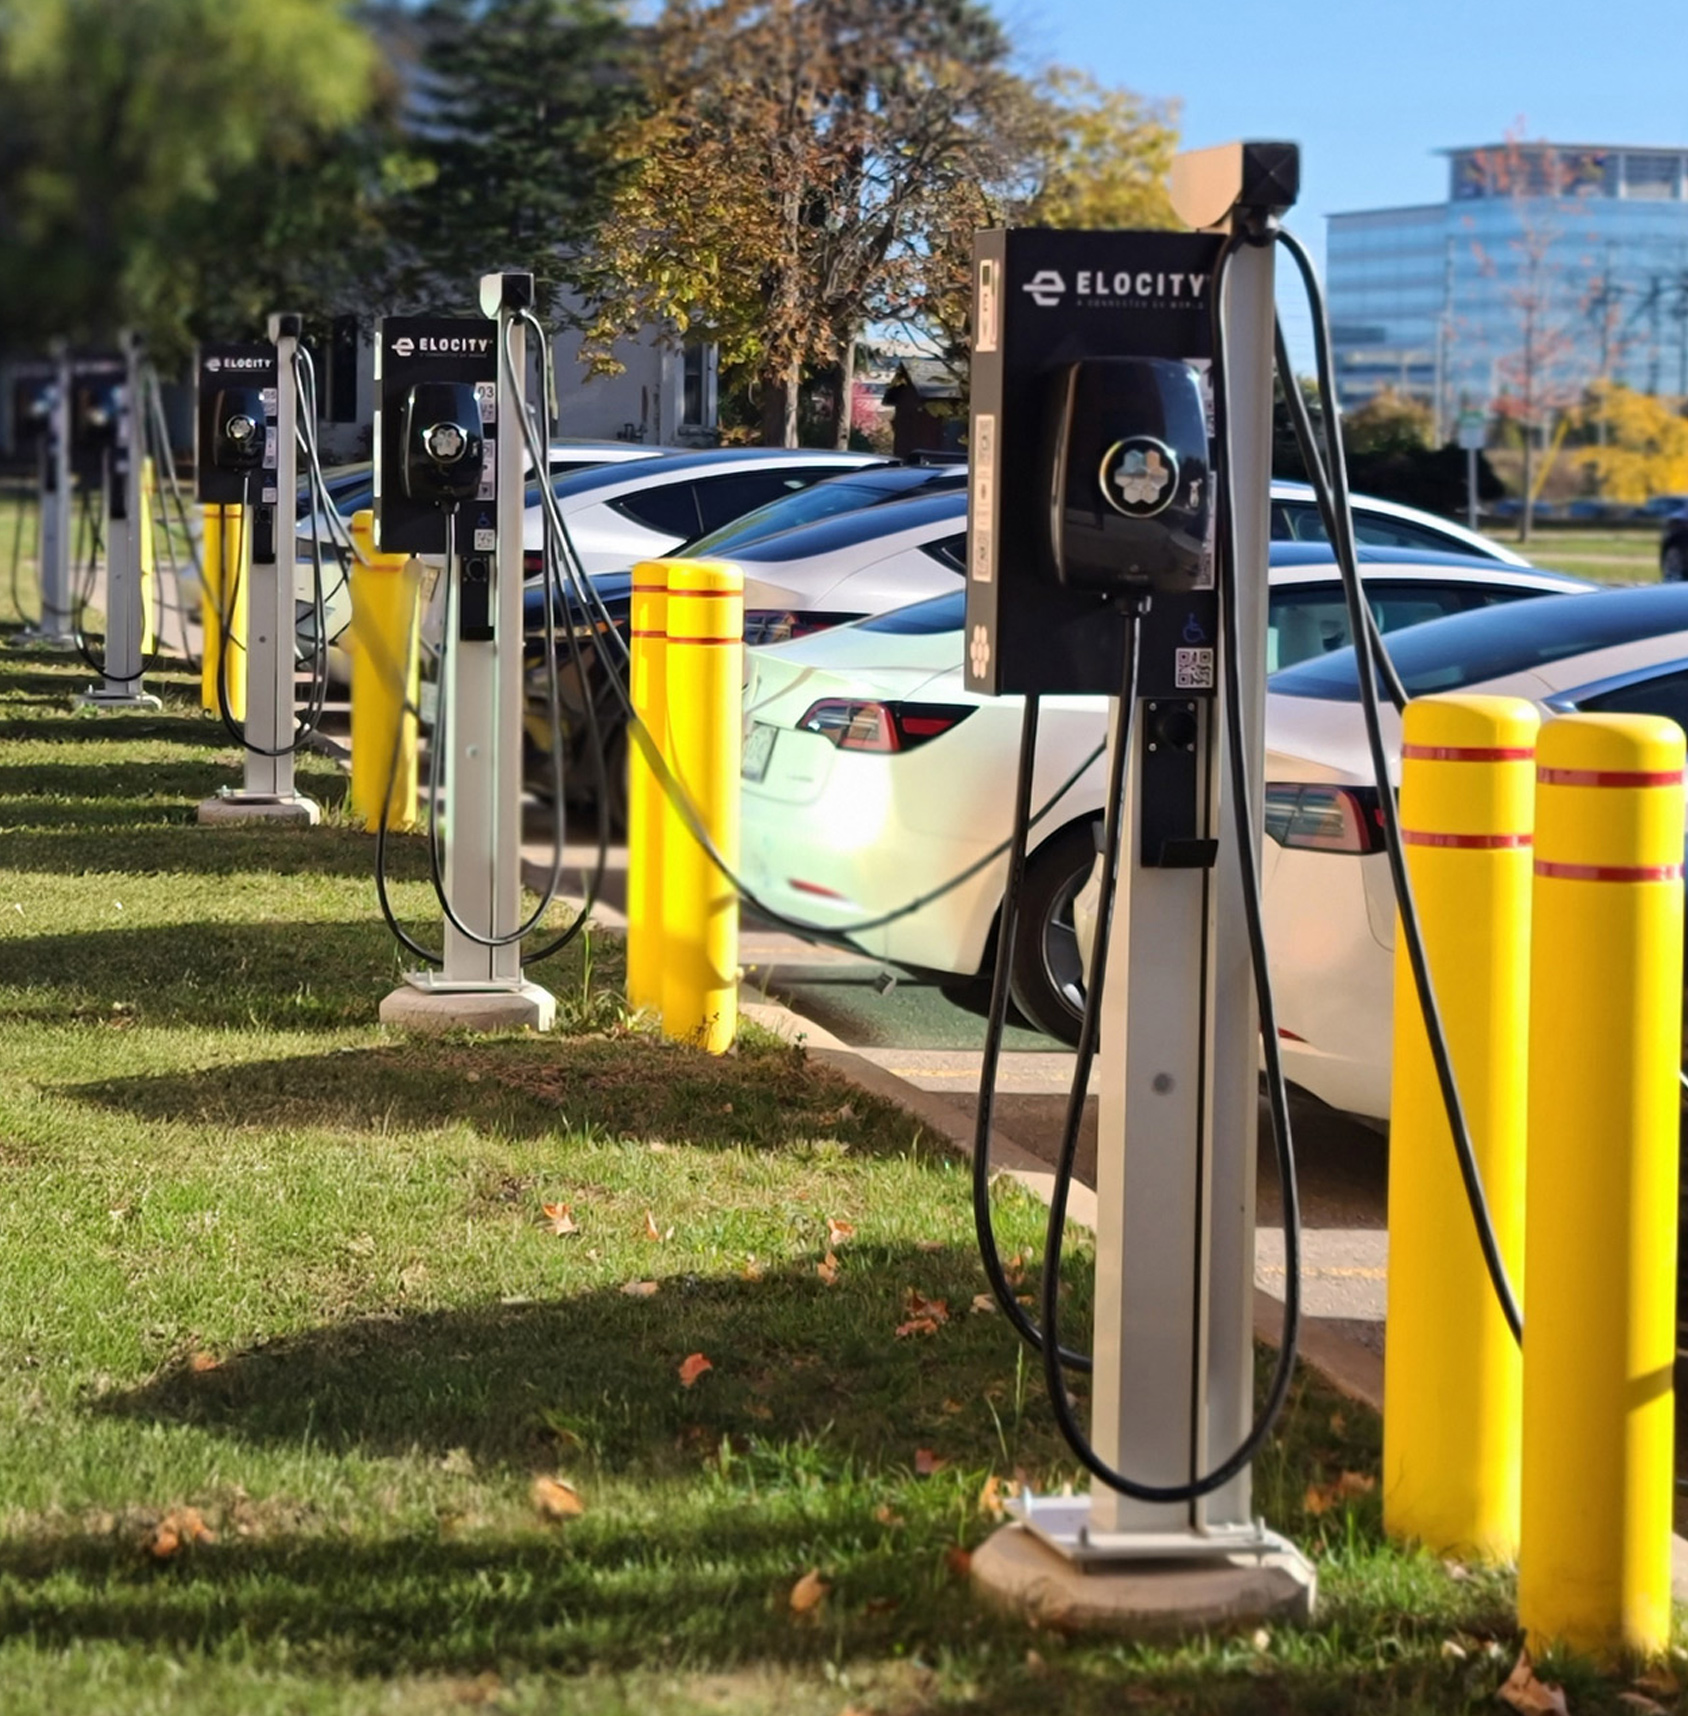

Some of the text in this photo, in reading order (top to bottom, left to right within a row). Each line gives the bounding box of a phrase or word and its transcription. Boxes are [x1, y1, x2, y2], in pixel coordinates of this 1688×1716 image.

[1076, 270, 1204, 297] ELOCITY
[419, 337, 488, 352] ELOCITY
[223, 357, 272, 368] ELOCITY
